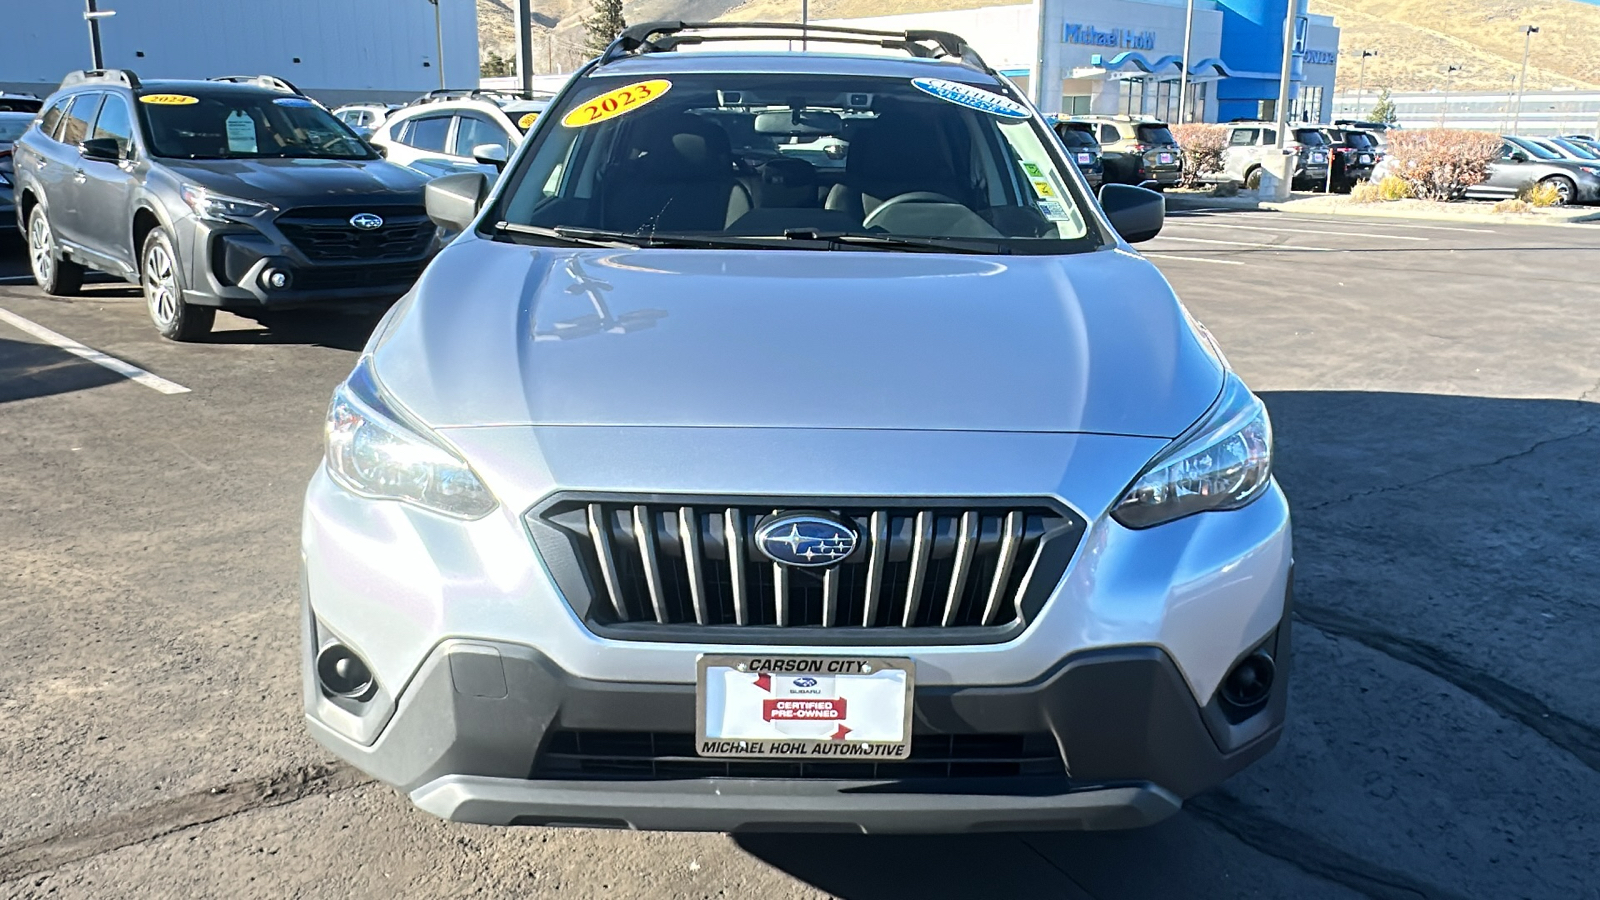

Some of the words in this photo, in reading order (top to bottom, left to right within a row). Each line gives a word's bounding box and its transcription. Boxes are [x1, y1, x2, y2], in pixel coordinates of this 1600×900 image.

[1063, 23, 1119, 47] Michael
[584, 85, 652, 120] 2023
[749, 658, 823, 673] CARSON
[827, 660, 868, 673] CITY
[776, 701, 833, 710] CERTIFIED
[771, 709, 839, 718] PRE-OWNED
[702, 741, 765, 754] MICHAEL
[769, 742, 808, 755] HOHL
[811, 743, 906, 756] AUTOMOTIVE
